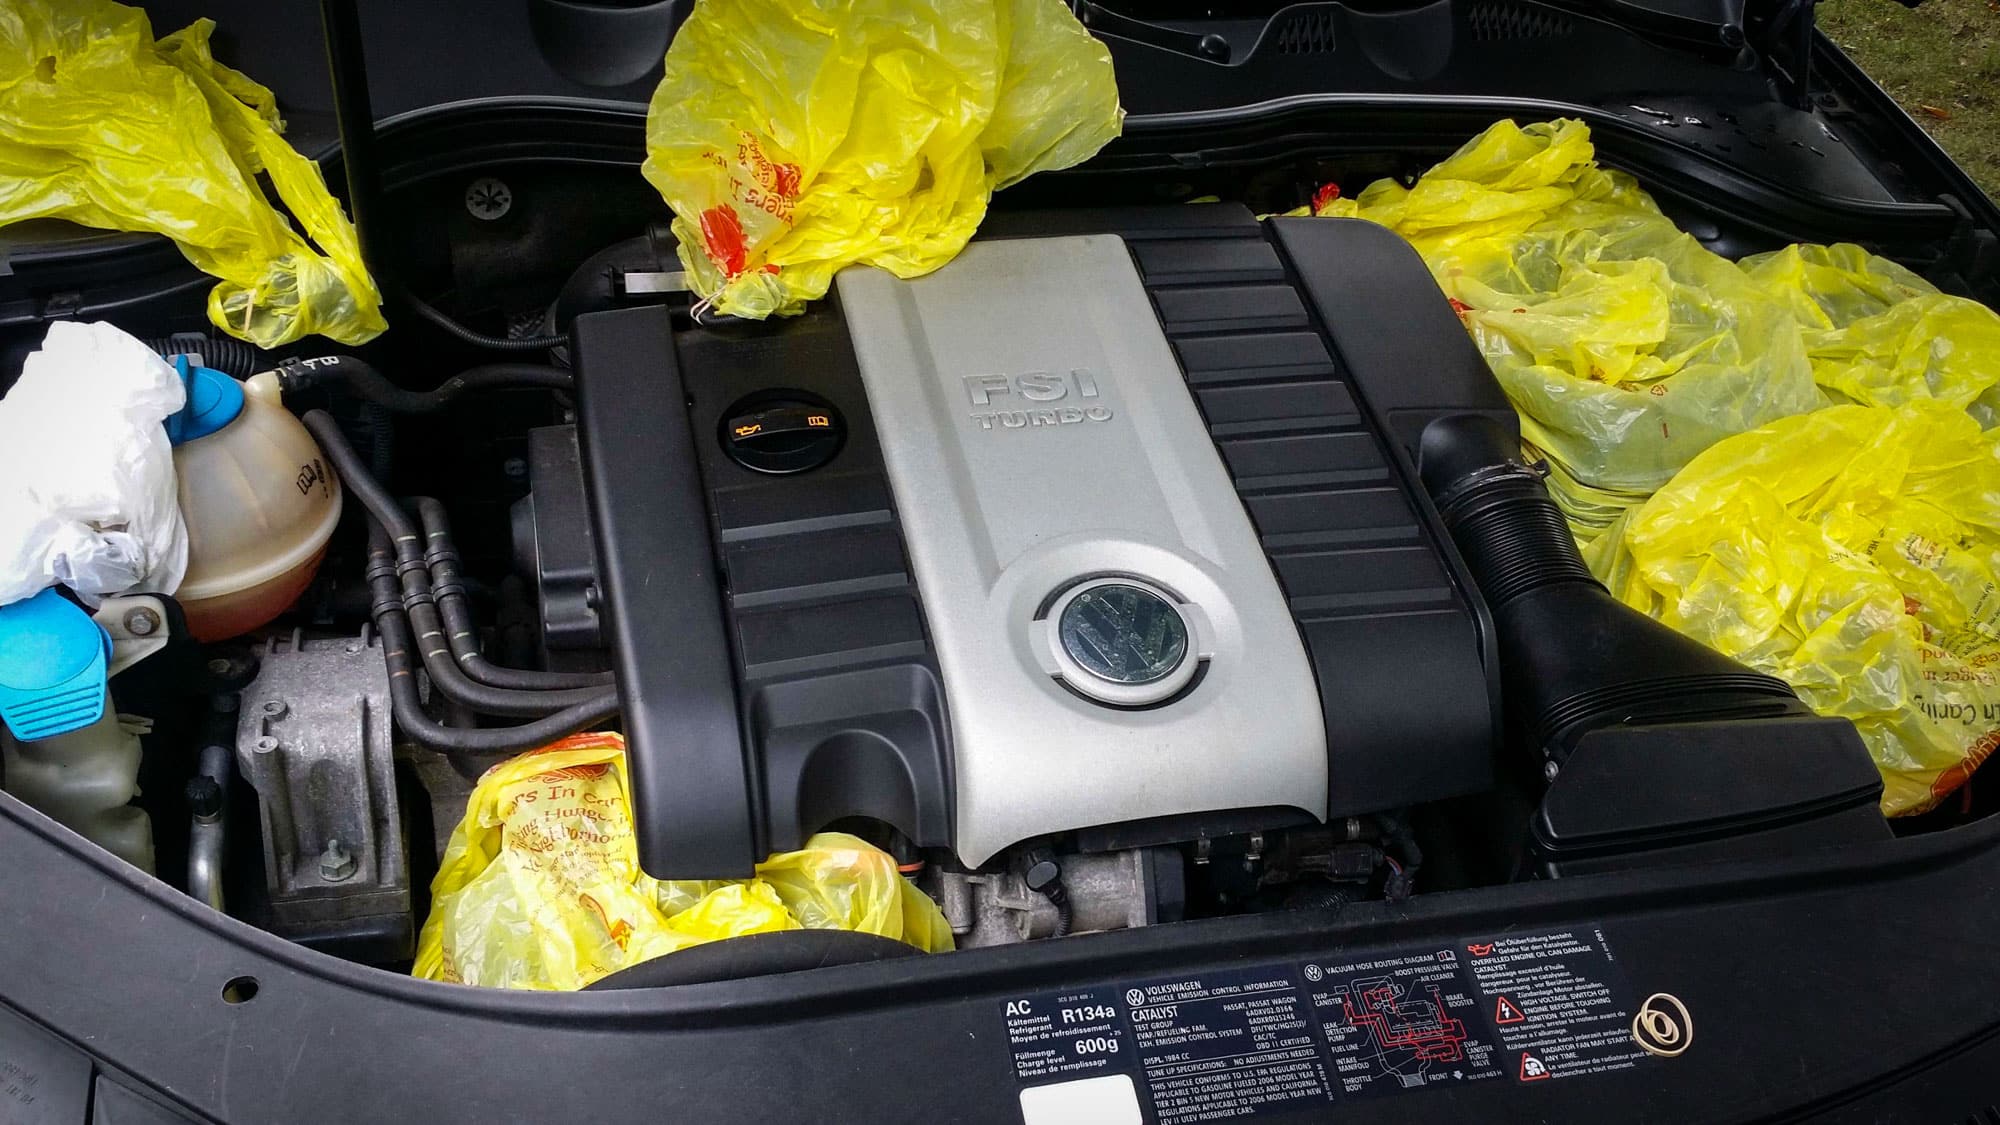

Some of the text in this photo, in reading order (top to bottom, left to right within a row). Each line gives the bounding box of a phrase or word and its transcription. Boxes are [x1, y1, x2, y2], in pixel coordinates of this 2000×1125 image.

[963, 368, 1099, 405] FSI
[970, 407, 1112, 430] TURBO
[1471, 956, 1509, 965] OVERFILLED
[1510, 952, 1536, 961] ENGINE
[1548, 948, 1563, 956] CAN
[1325, 954, 1435, 975] VACUUM HOSE ROUTING DIAGRAM
[1394, 962, 1460, 976] BOOST PRESSURE VALVE
[1474, 963, 1507, 974] CATALYST
[1430, 972, 1455, 981] CLEANER
[1145, 980, 1202, 996] VOLKSWAGEN
[1148, 980, 1289, 1003] VEHICLE EMISSION CONTROL INFORMATION
[1248, 1000, 1270, 1009] PASSAT
[1271, 996, 1297, 1005] WAGON
[1312, 992, 1328, 1001] EVAP
[1315, 997, 1343, 1007] CANISTER
[1520, 998, 1538, 1006] HIGH
[1006, 1000, 1031, 1017] AC
[1448, 998, 1475, 1008] BOOSTER
[1523, 997, 1611, 1014] ENGINE BEFORE TOUCHING
[1062, 1005, 1116, 1024] R134a
[1131, 1005, 1178, 1022] CATALYST
[1527, 1012, 1558, 1022] IGNITION
[1008, 1015, 1050, 1027] Kältemittel
[1134, 1020, 1173, 1032] TEST GROUP
[1323, 1021, 1338, 1030] LEAK
[1009, 1024, 1053, 1036] Refrigerant
[1011, 1024, 1111, 1044] Moyen de refroidissement
[1325, 1026, 1358, 1036] DETECTION
[1156, 1036, 1186, 1046] EMISSION
[1188, 1032, 1217, 1041] CONTROL
[1218, 1028, 1243, 1038] SYSTEM
[1256, 1041, 1271, 1050] OBD
[1280, 1036, 1311, 1047] CERTIFIED
[1327, 1034, 1345, 1043] PUMP
[1075, 1037, 1119, 1055] 600g
[1331, 1043, 1360, 1053] FUEL LINE
[1463, 1040, 1479, 1048] EVAP
[1466, 1044, 1494, 1054] CANISTER
[1540, 1043, 1576, 1054] RADIATOR
[1590, 1039, 1606, 1047] MAY
[1606, 1035, 1628, 1045] START
[1015, 1049, 1056, 1060] Füllmenge
[1165, 1054, 1181, 1062] 1984
[1181, 1052, 1190, 1060] CC
[1335, 1056, 1358, 1065] INTAKE
[1544, 1053, 1559, 1062] ANY
[1017, 1055, 1065, 1069] Charge level
[1019, 1058, 1107, 1078] Niveau de remplissage
[1147, 1069, 1165, 1078] TUNE
[1166, 1067, 1175, 1075] UP
[1233, 1058, 1244, 1066] NO
[1246, 1052, 1289, 1063] ADJUSTMENTS
[1290, 1048, 1315, 1058] NEEDED
[1338, 1062, 1370, 1072] MANIFOLD
[1471, 1059, 1491, 1067] VALVE
[1150, 1082, 1166, 1091] THIS
[1167, 1079, 1193, 1088] VEHICLE
[1195, 1073, 1231, 1085] CONFORMS
[1232, 1072, 1241, 1080] TO
[1256, 1068, 1269, 1076] EPA
[1269, 1062, 1311, 1074] REGULATIONS
[1342, 1075, 1373, 1085] THROTTLE
[1428, 1072, 1448, 1081] FRONT
[1153, 1070, 1315, 1098] APPLICABLE TO GASOLINE FUELED 2006 MODEL YEAR
[1345, 1084, 1362, 1092] BODY
[1155, 1100, 1170, 1109] TIER
[1194, 1094, 1210, 1102] NEW
[1211, 1091, 1235, 1099] MOTOR
[1235, 1086, 1265, 1097] VEHICLES
[1266, 1084, 1280, 1093] AND
[1281, 1080, 1318, 1090] CALIFORNIA
[1158, 1087, 1322, 1117] REGULATIONS APPLICABLE TO 2006 MODEL YEAR NEW
[1180, 1114, 1198, 1123] ULEV
[1199, 1109, 1235, 1120] PASSENGER
